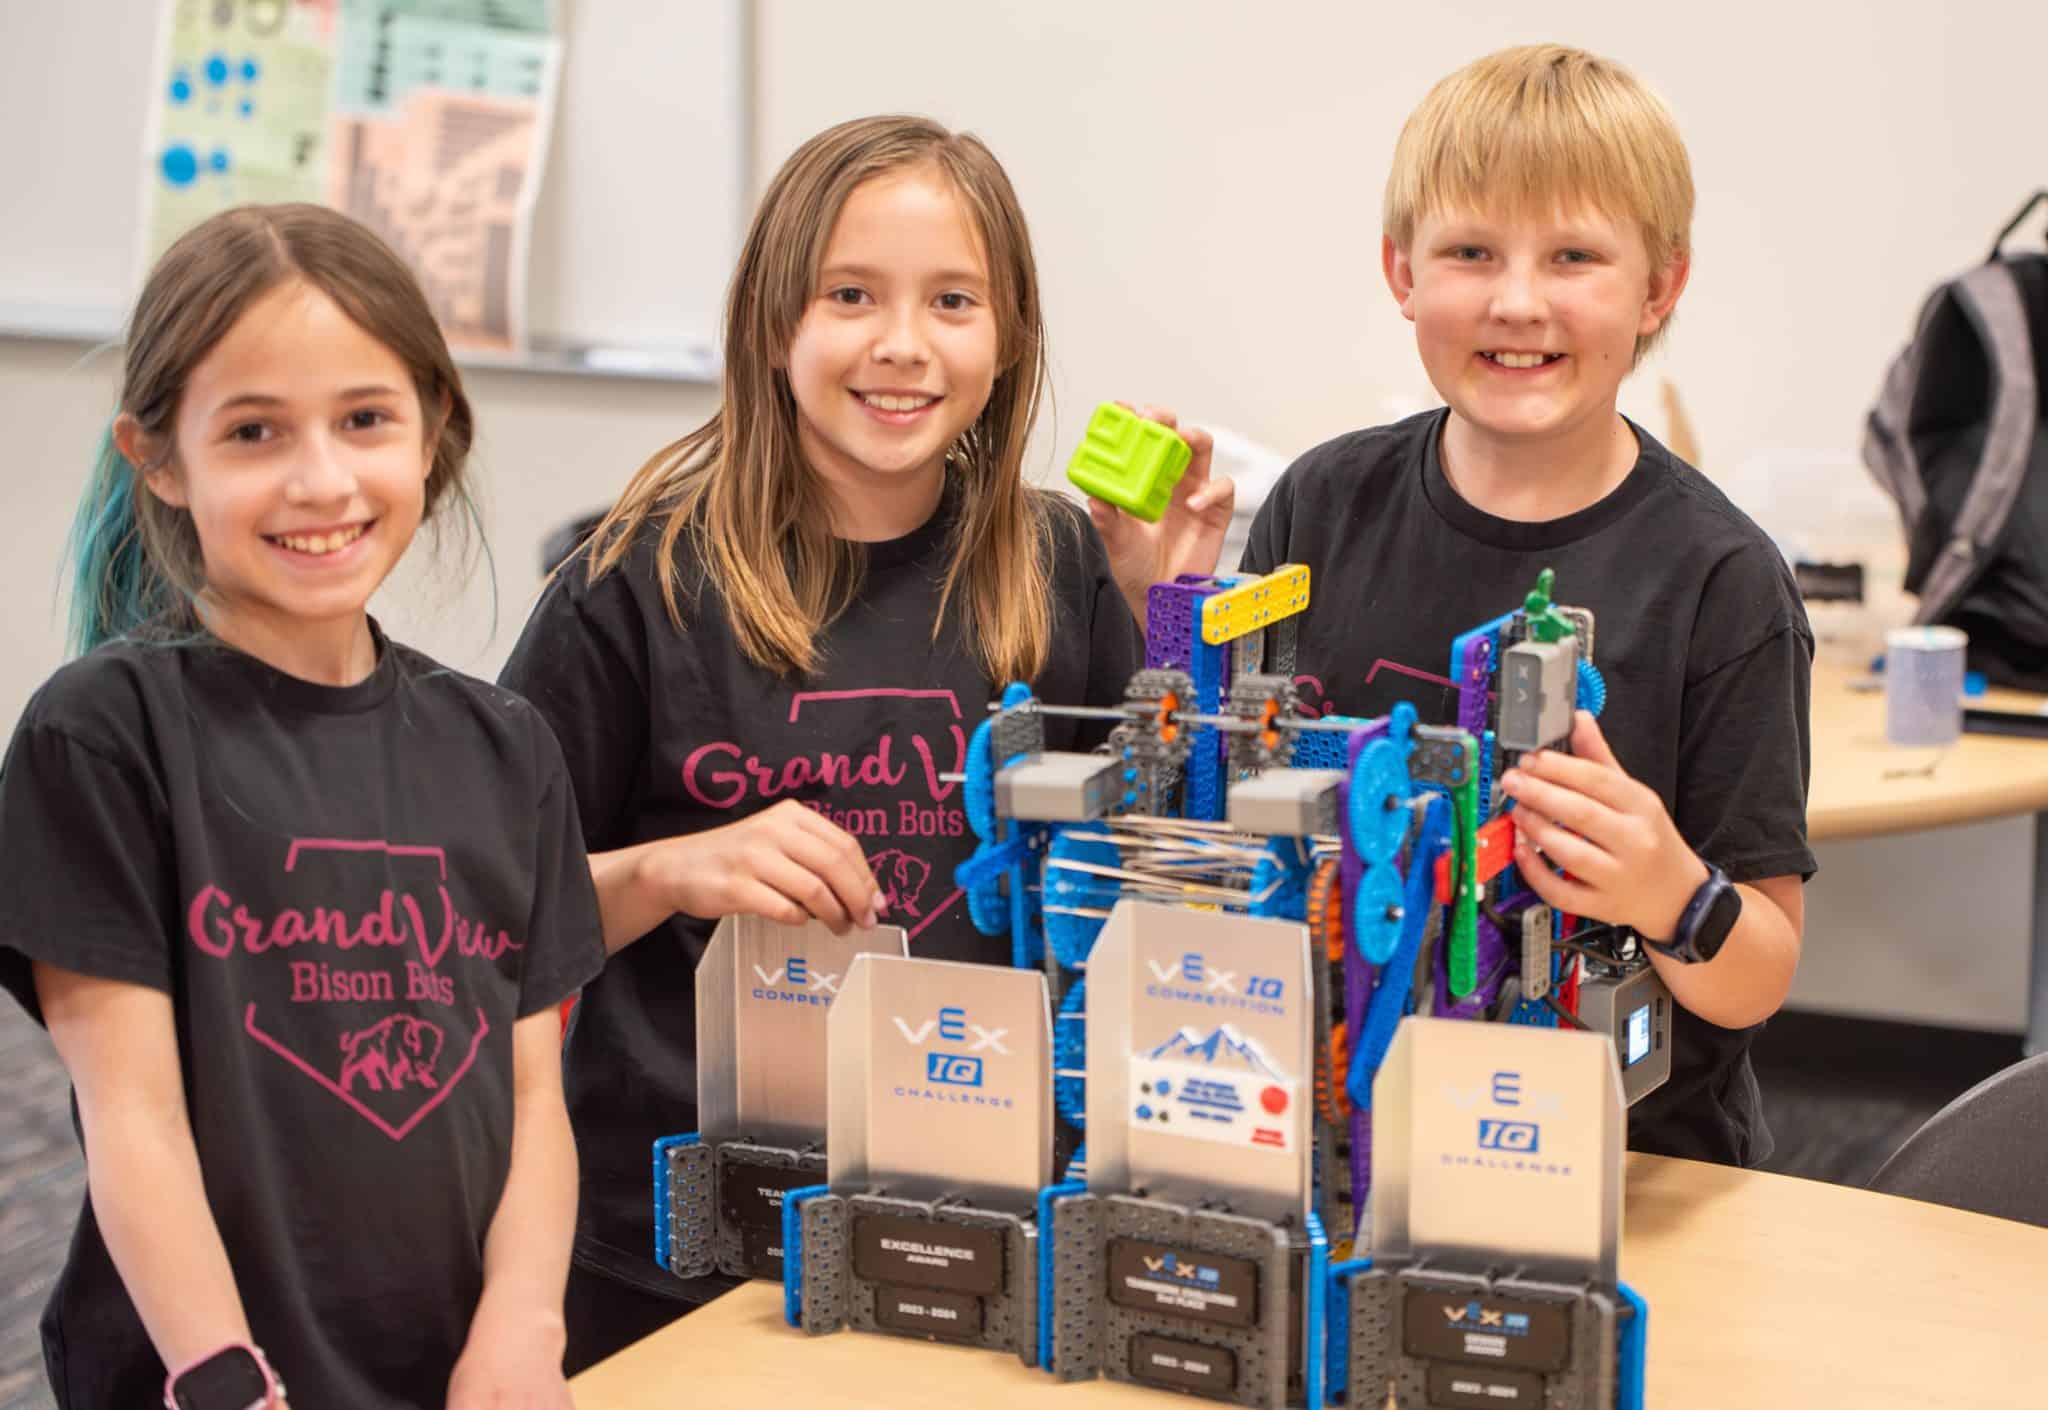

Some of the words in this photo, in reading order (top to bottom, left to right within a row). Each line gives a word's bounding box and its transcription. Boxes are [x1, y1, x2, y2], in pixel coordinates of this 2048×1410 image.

[683, 735, 907, 808] Grand
[898, 800, 964, 836] Bots
[188, 885, 408, 958] Grand
[289, 961, 394, 1002] Bison
[753, 958, 839, 993] VEX
[1148, 953, 1237, 993] VEX
[752, 988, 832, 1006] COMPET
[892, 1007, 1010, 1054] VEX
[930, 1055, 980, 1084] IQ
[894, 1087, 1013, 1108] CHALLENGE
[1482, 1122, 1536, 1151] IQ
[757, 1187, 784, 1199] TEA
[880, 1238, 975, 1261] EXCELLENCE
